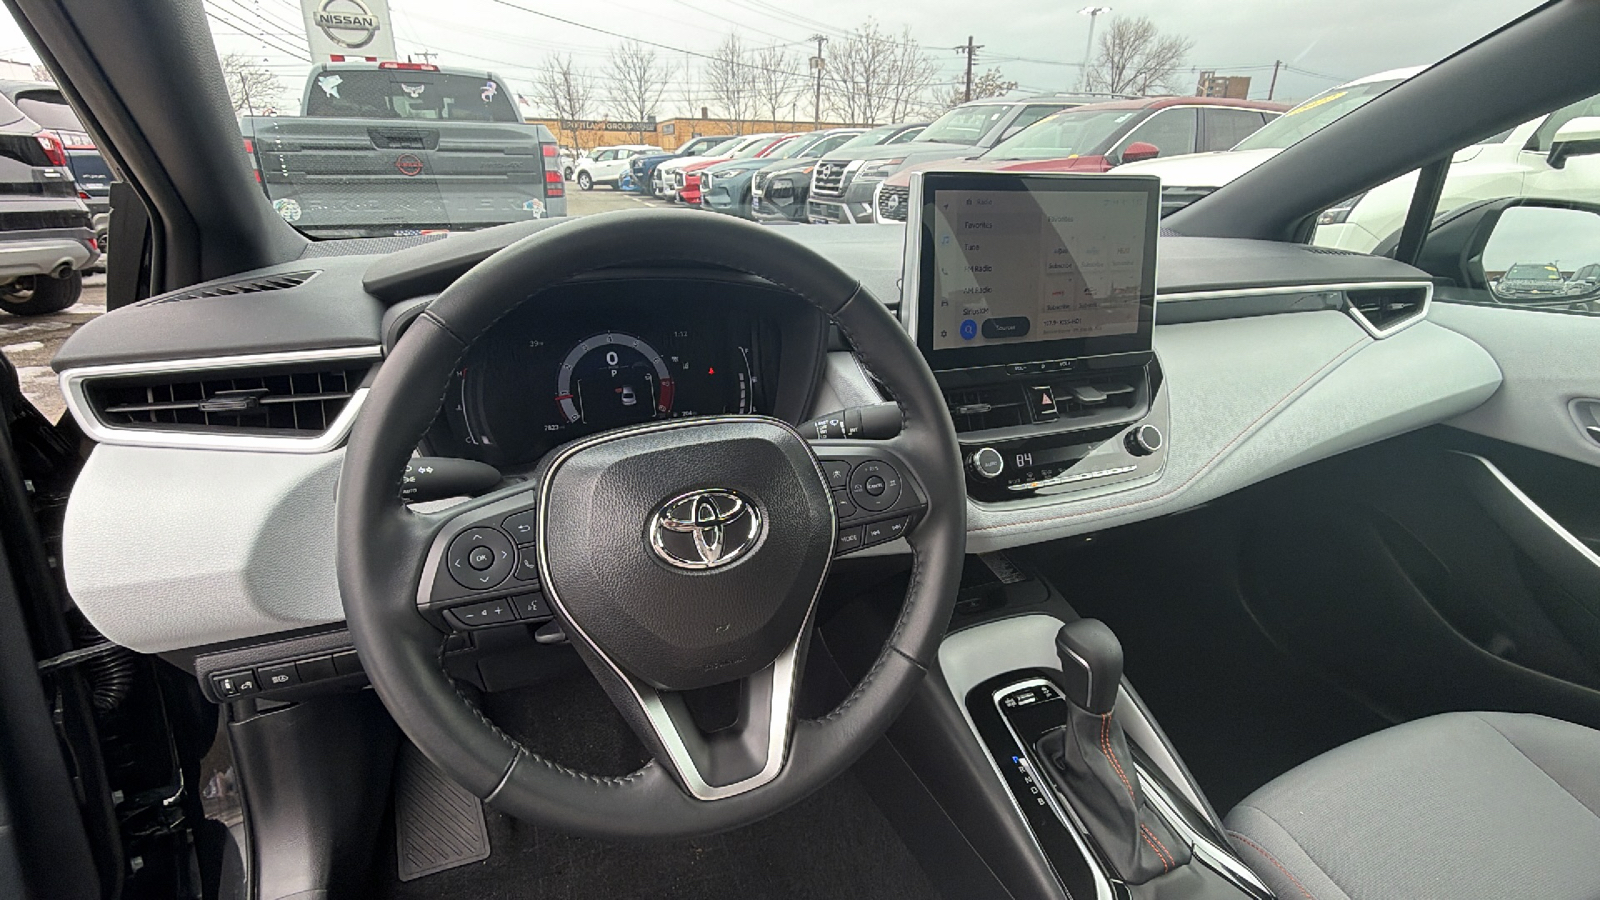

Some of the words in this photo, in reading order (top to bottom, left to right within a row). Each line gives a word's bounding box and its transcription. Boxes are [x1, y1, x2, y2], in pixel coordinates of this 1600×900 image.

[319, 14, 373, 26] NISSAN
[964, 221, 993, 229] Favorites
[964, 243, 980, 251] Tune
[974, 265, 993, 273] Radio
[606, 351, 619, 366] 0
[611, 369, 617, 378] P
[1016, 452, 1033, 468] 84
[475, 554, 488, 562] OK
